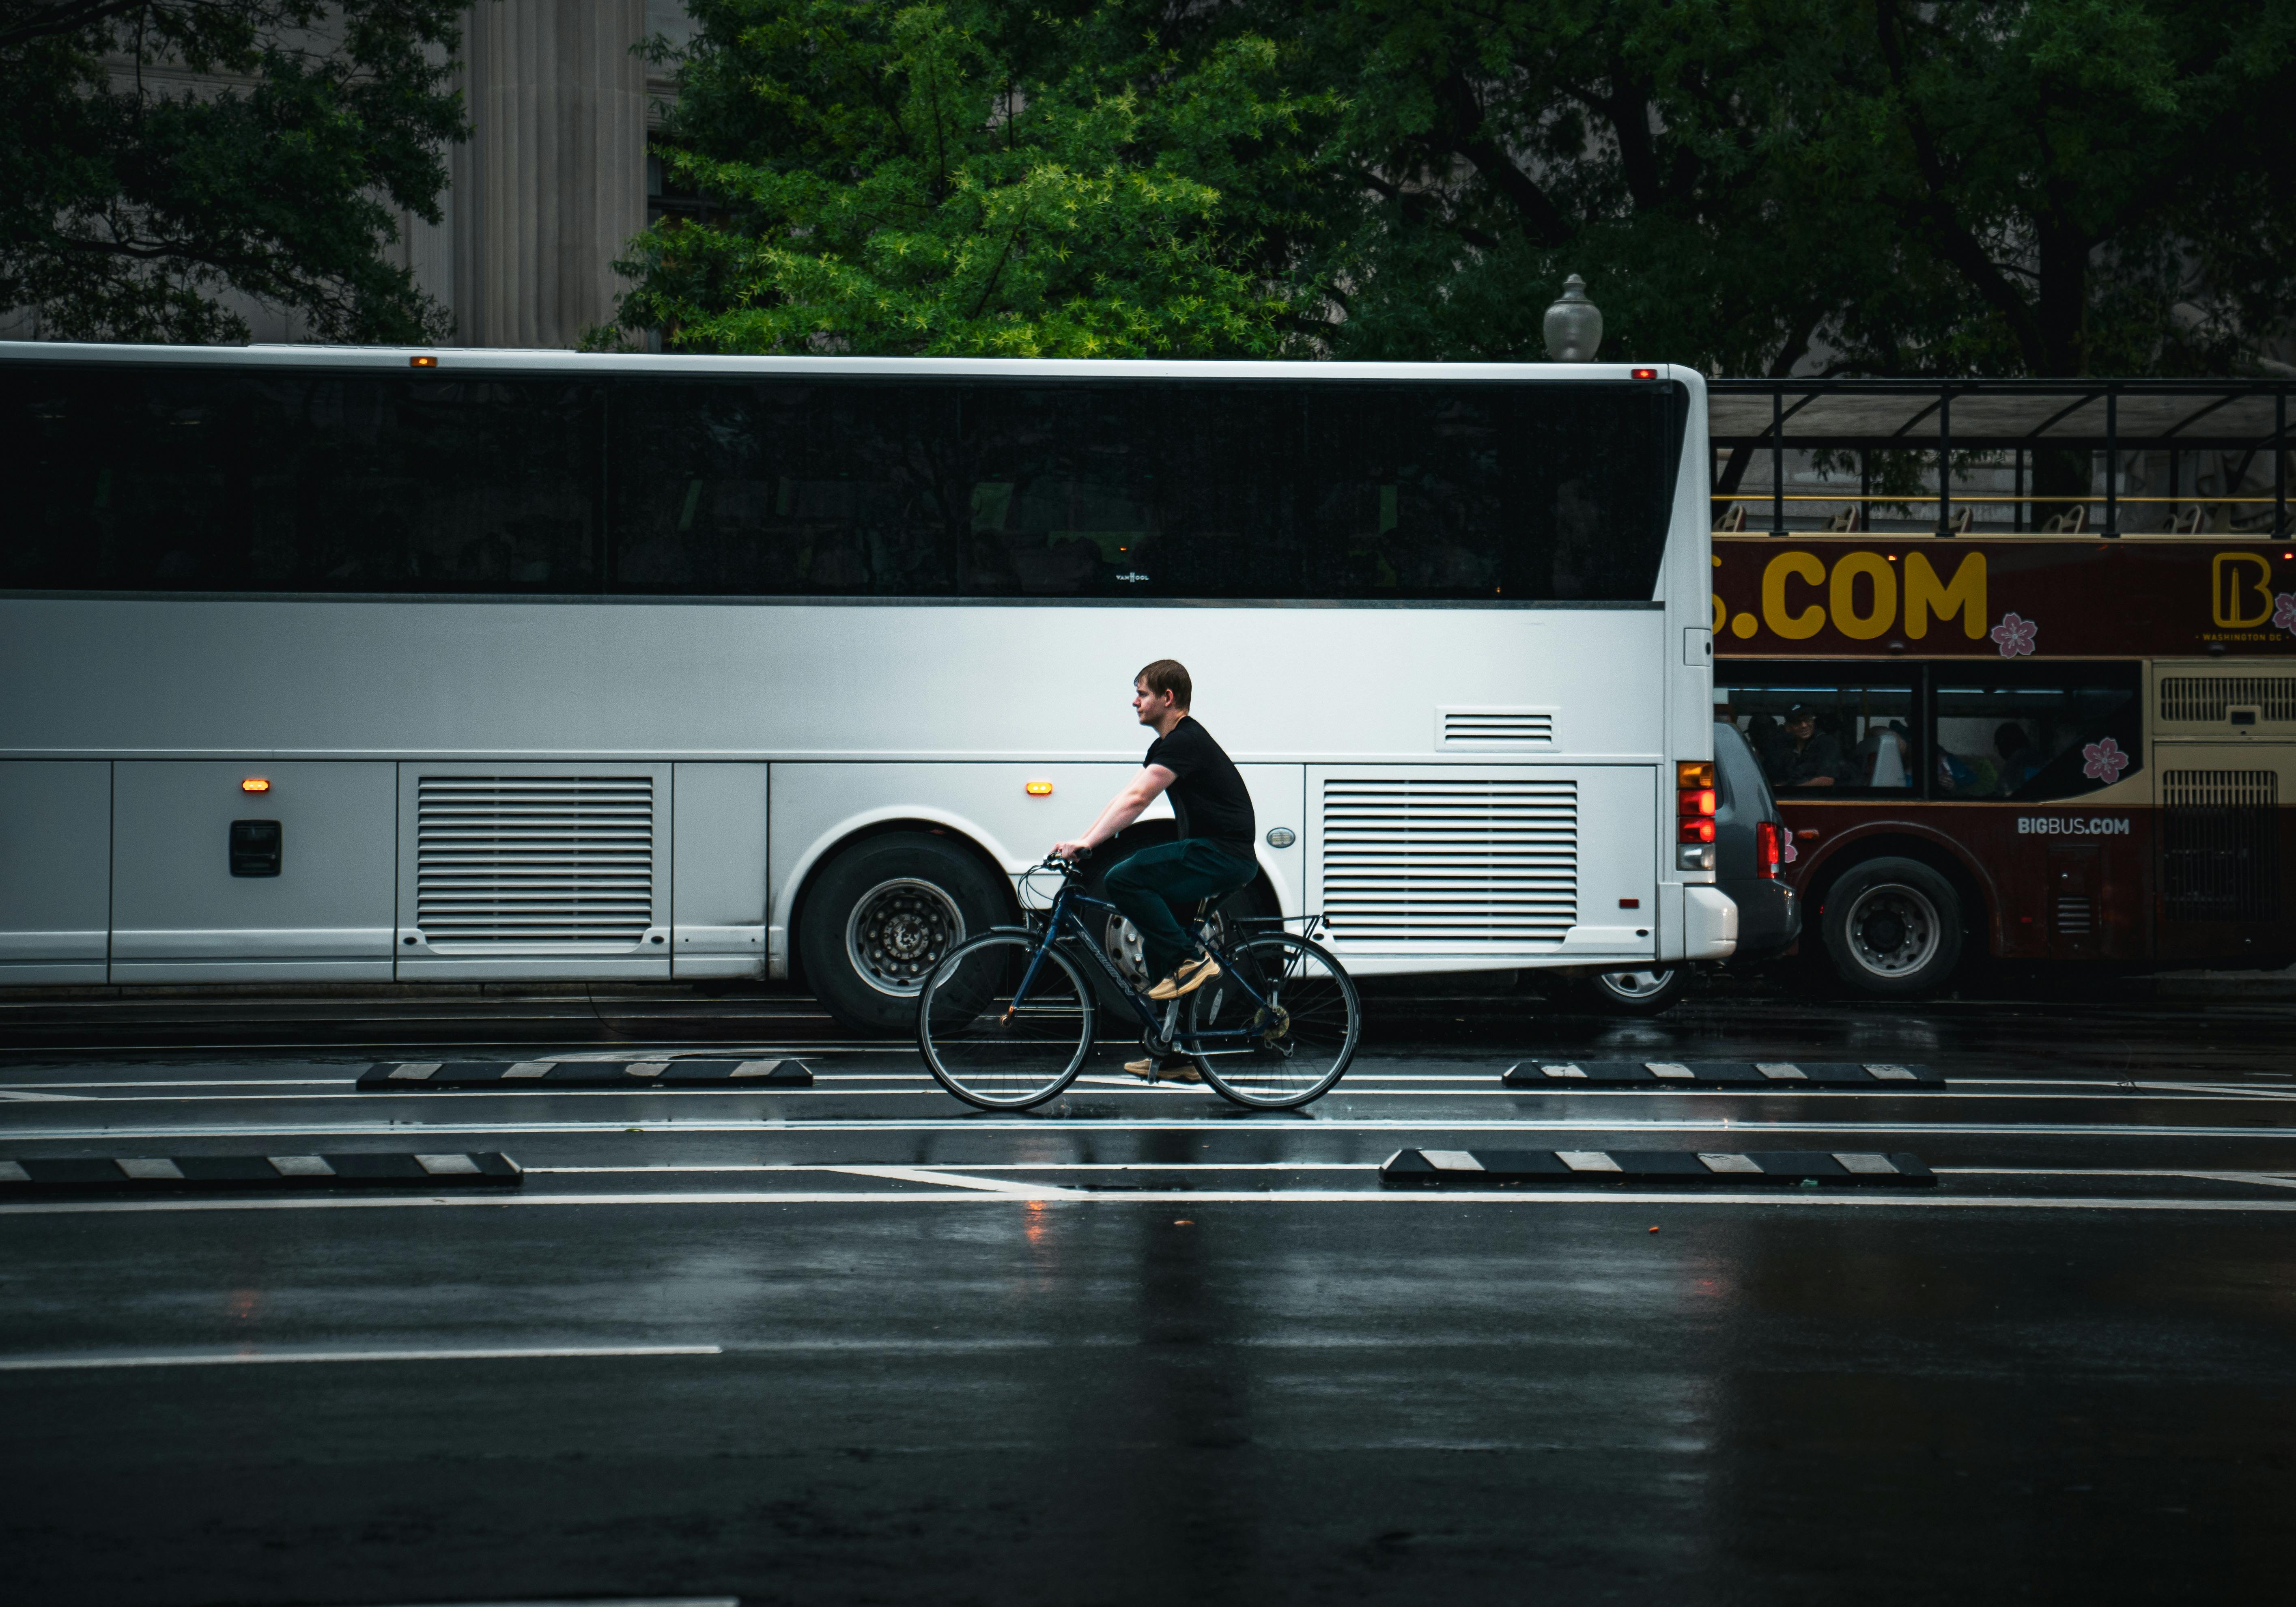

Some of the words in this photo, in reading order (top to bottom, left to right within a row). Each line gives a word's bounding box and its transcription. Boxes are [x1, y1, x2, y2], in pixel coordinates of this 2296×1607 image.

[1713, 551, 1987, 640] .COM
[2203, 633, 2266, 641] WASHINGTON
[2269, 633, 2281, 641] DC
[2018, 817, 2130, 834] BIGBUS.COM
